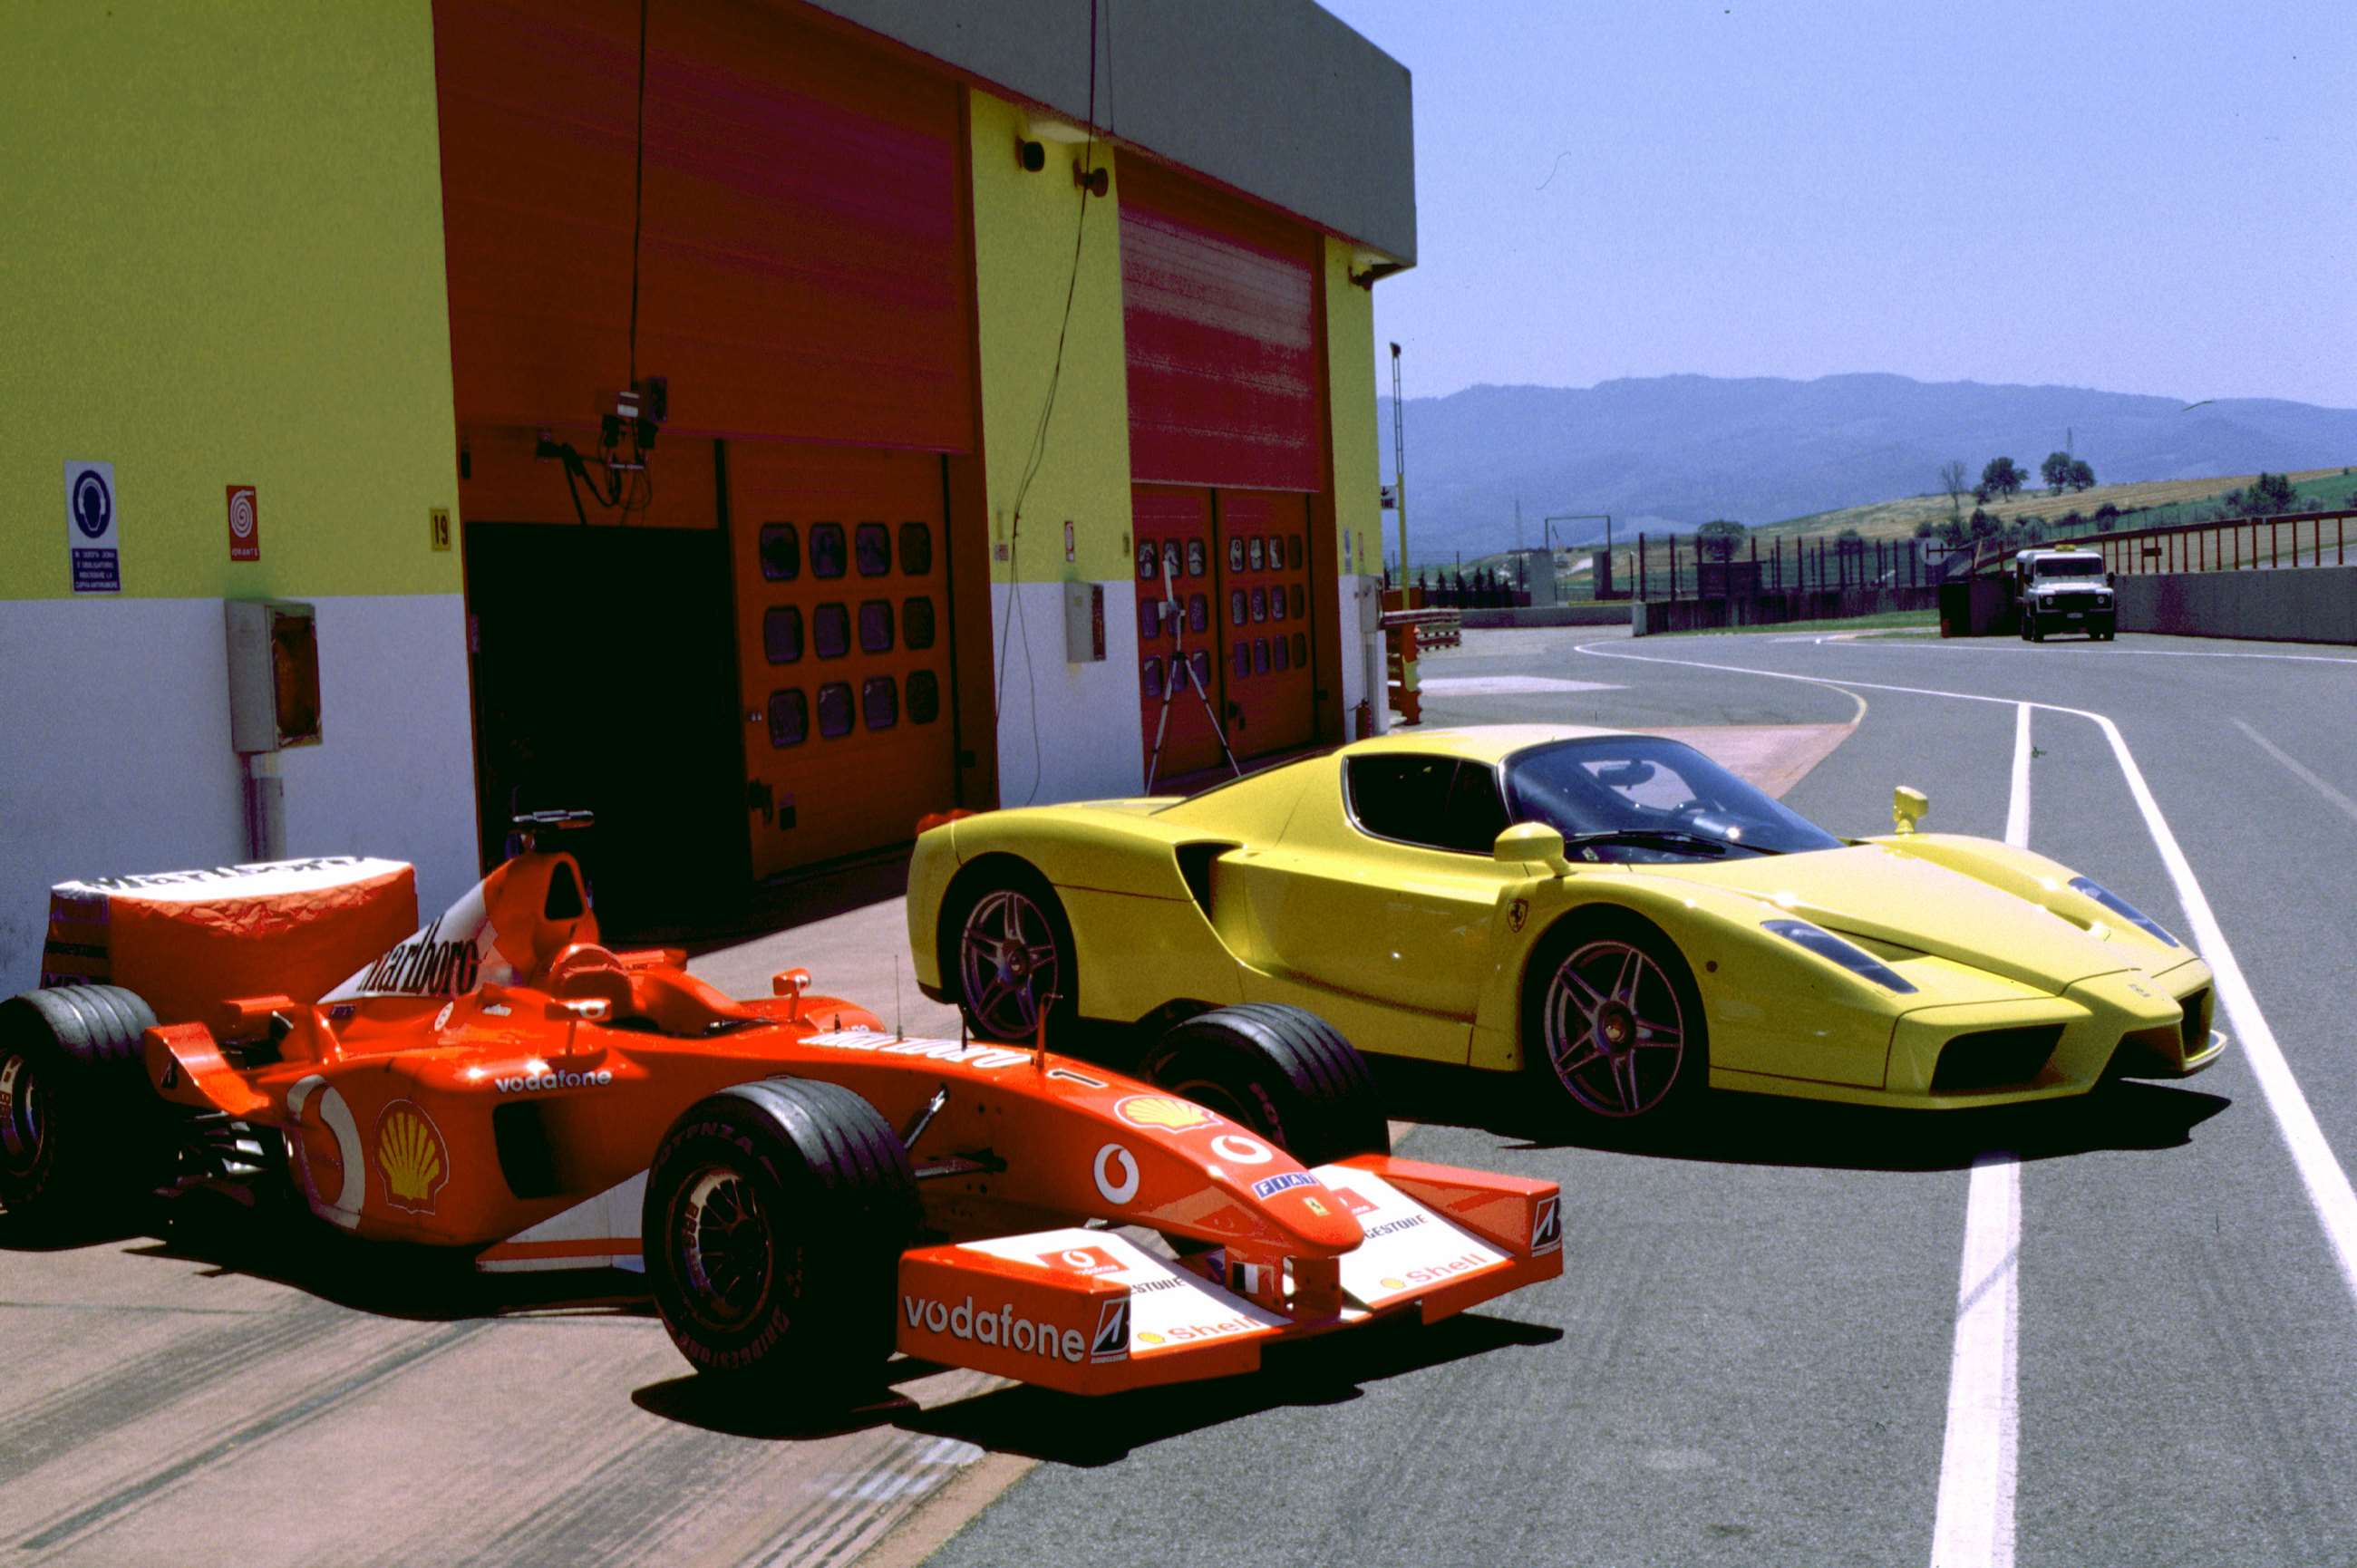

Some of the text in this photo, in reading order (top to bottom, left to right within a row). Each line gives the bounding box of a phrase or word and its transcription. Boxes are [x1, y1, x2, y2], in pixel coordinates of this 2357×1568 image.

[433, 514, 450, 546] 19
[494, 1070, 613, 1093] vodafone
[1256, 1173, 1315, 1196] FIAT
[1406, 1253, 1489, 1284] Shell
[904, 1295, 1087, 1363] vodafone
[1168, 1315, 1260, 1341] Shell
